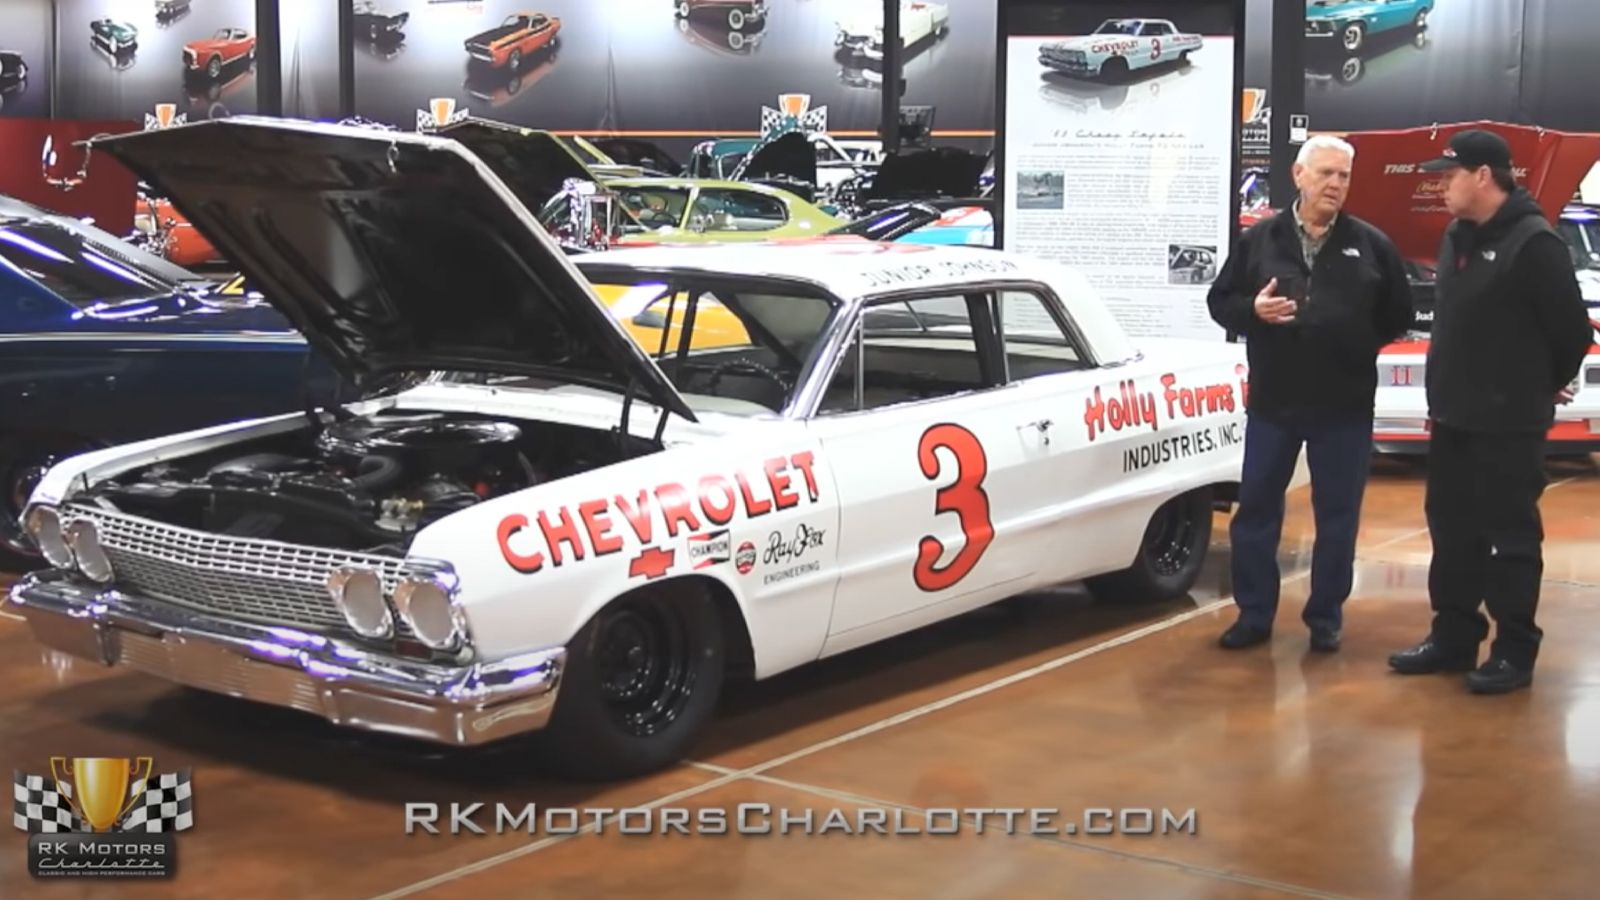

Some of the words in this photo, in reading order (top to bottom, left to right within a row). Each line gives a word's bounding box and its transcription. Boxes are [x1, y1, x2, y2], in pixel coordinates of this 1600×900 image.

[1150, 38, 1161, 60] 3
[1084, 379, 1158, 442] Holly
[1160, 372, 1236, 420] Farms
[497, 450, 820, 574] CHEVROLET
[913, 422, 995, 592] 3
[690, 540, 728, 558] CHAMPION
[763, 560, 820, 585] ENGINEERING
